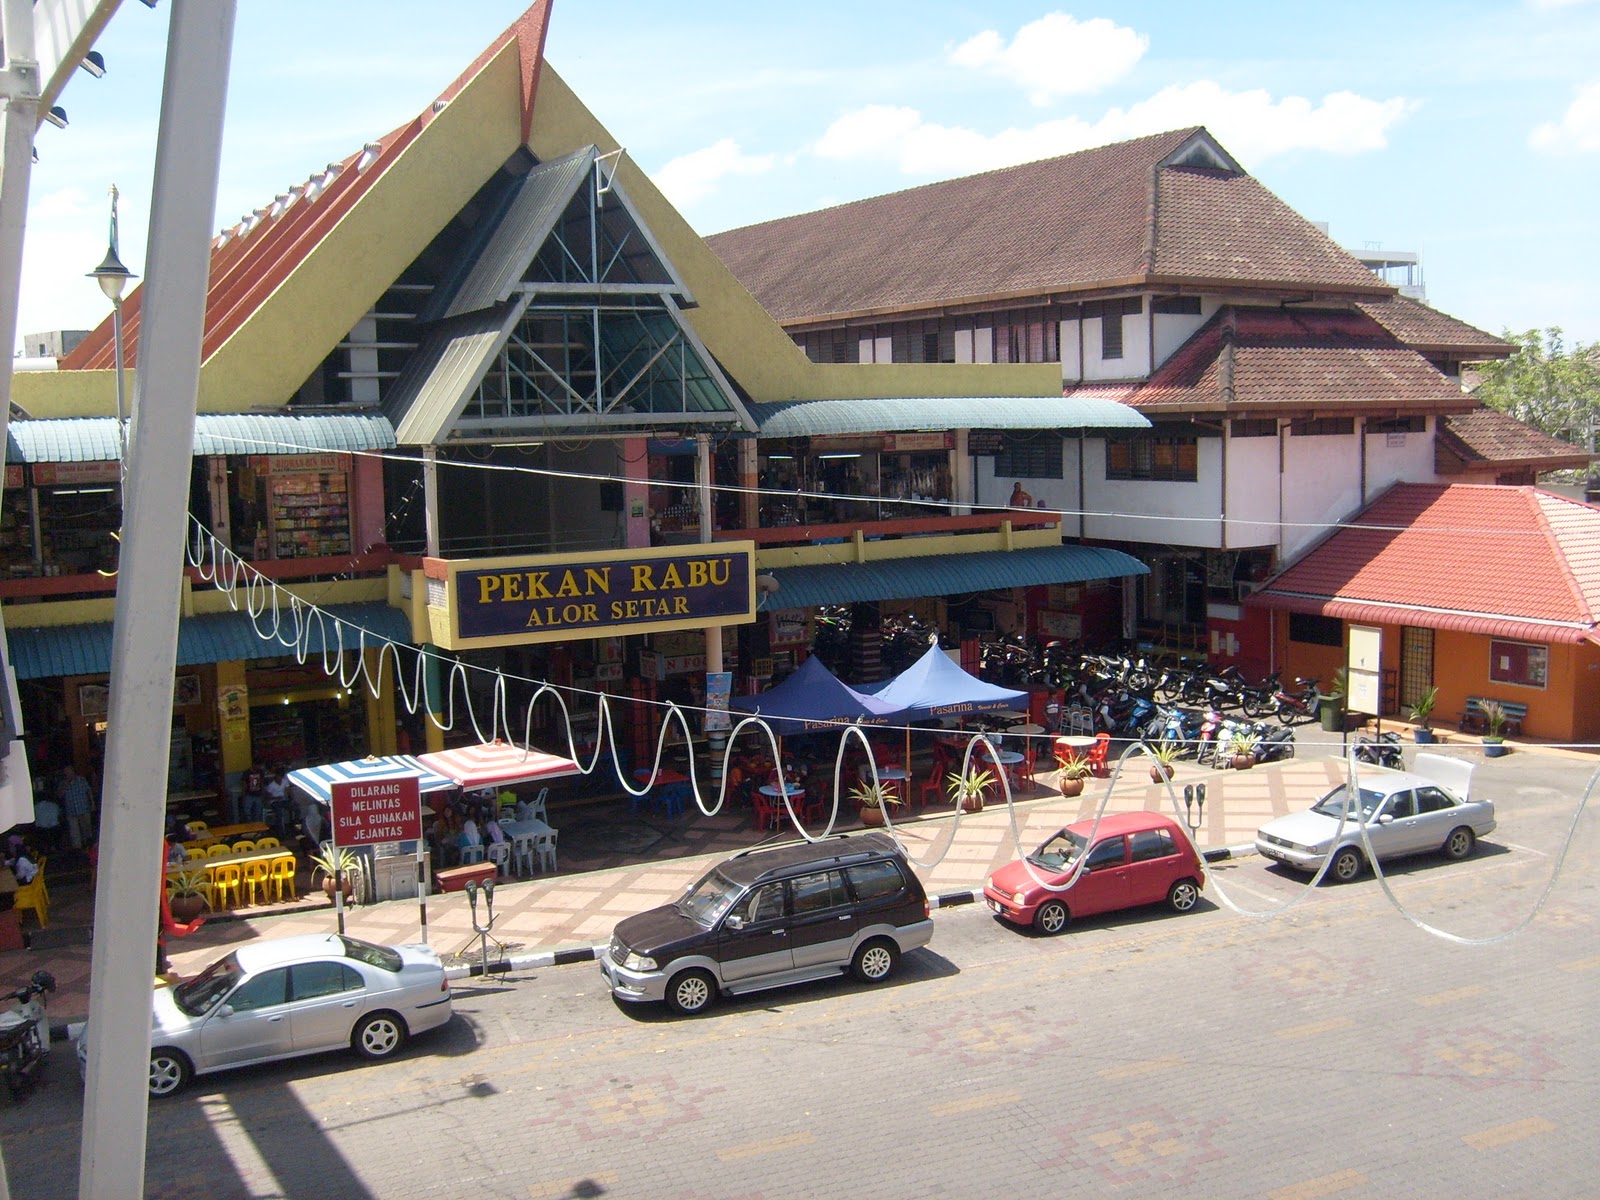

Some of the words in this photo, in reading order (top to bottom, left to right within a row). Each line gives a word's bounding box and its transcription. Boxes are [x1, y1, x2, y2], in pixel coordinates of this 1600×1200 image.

[477, 567, 612, 604] PEKAN
[631, 558, 733, 593] RABU
[525, 603, 600, 628] ALOR
[611, 595, 690, 620] SETAR
[929, 702, 974, 716] Pasarina
[350, 784, 400, 798] DILARANG
[352, 798, 401, 812] MELINTAS
[339, 815, 362, 827] SILA
[368, 810, 416, 825] GUNAKAN
[353, 826, 403, 840] JEJANTAS
